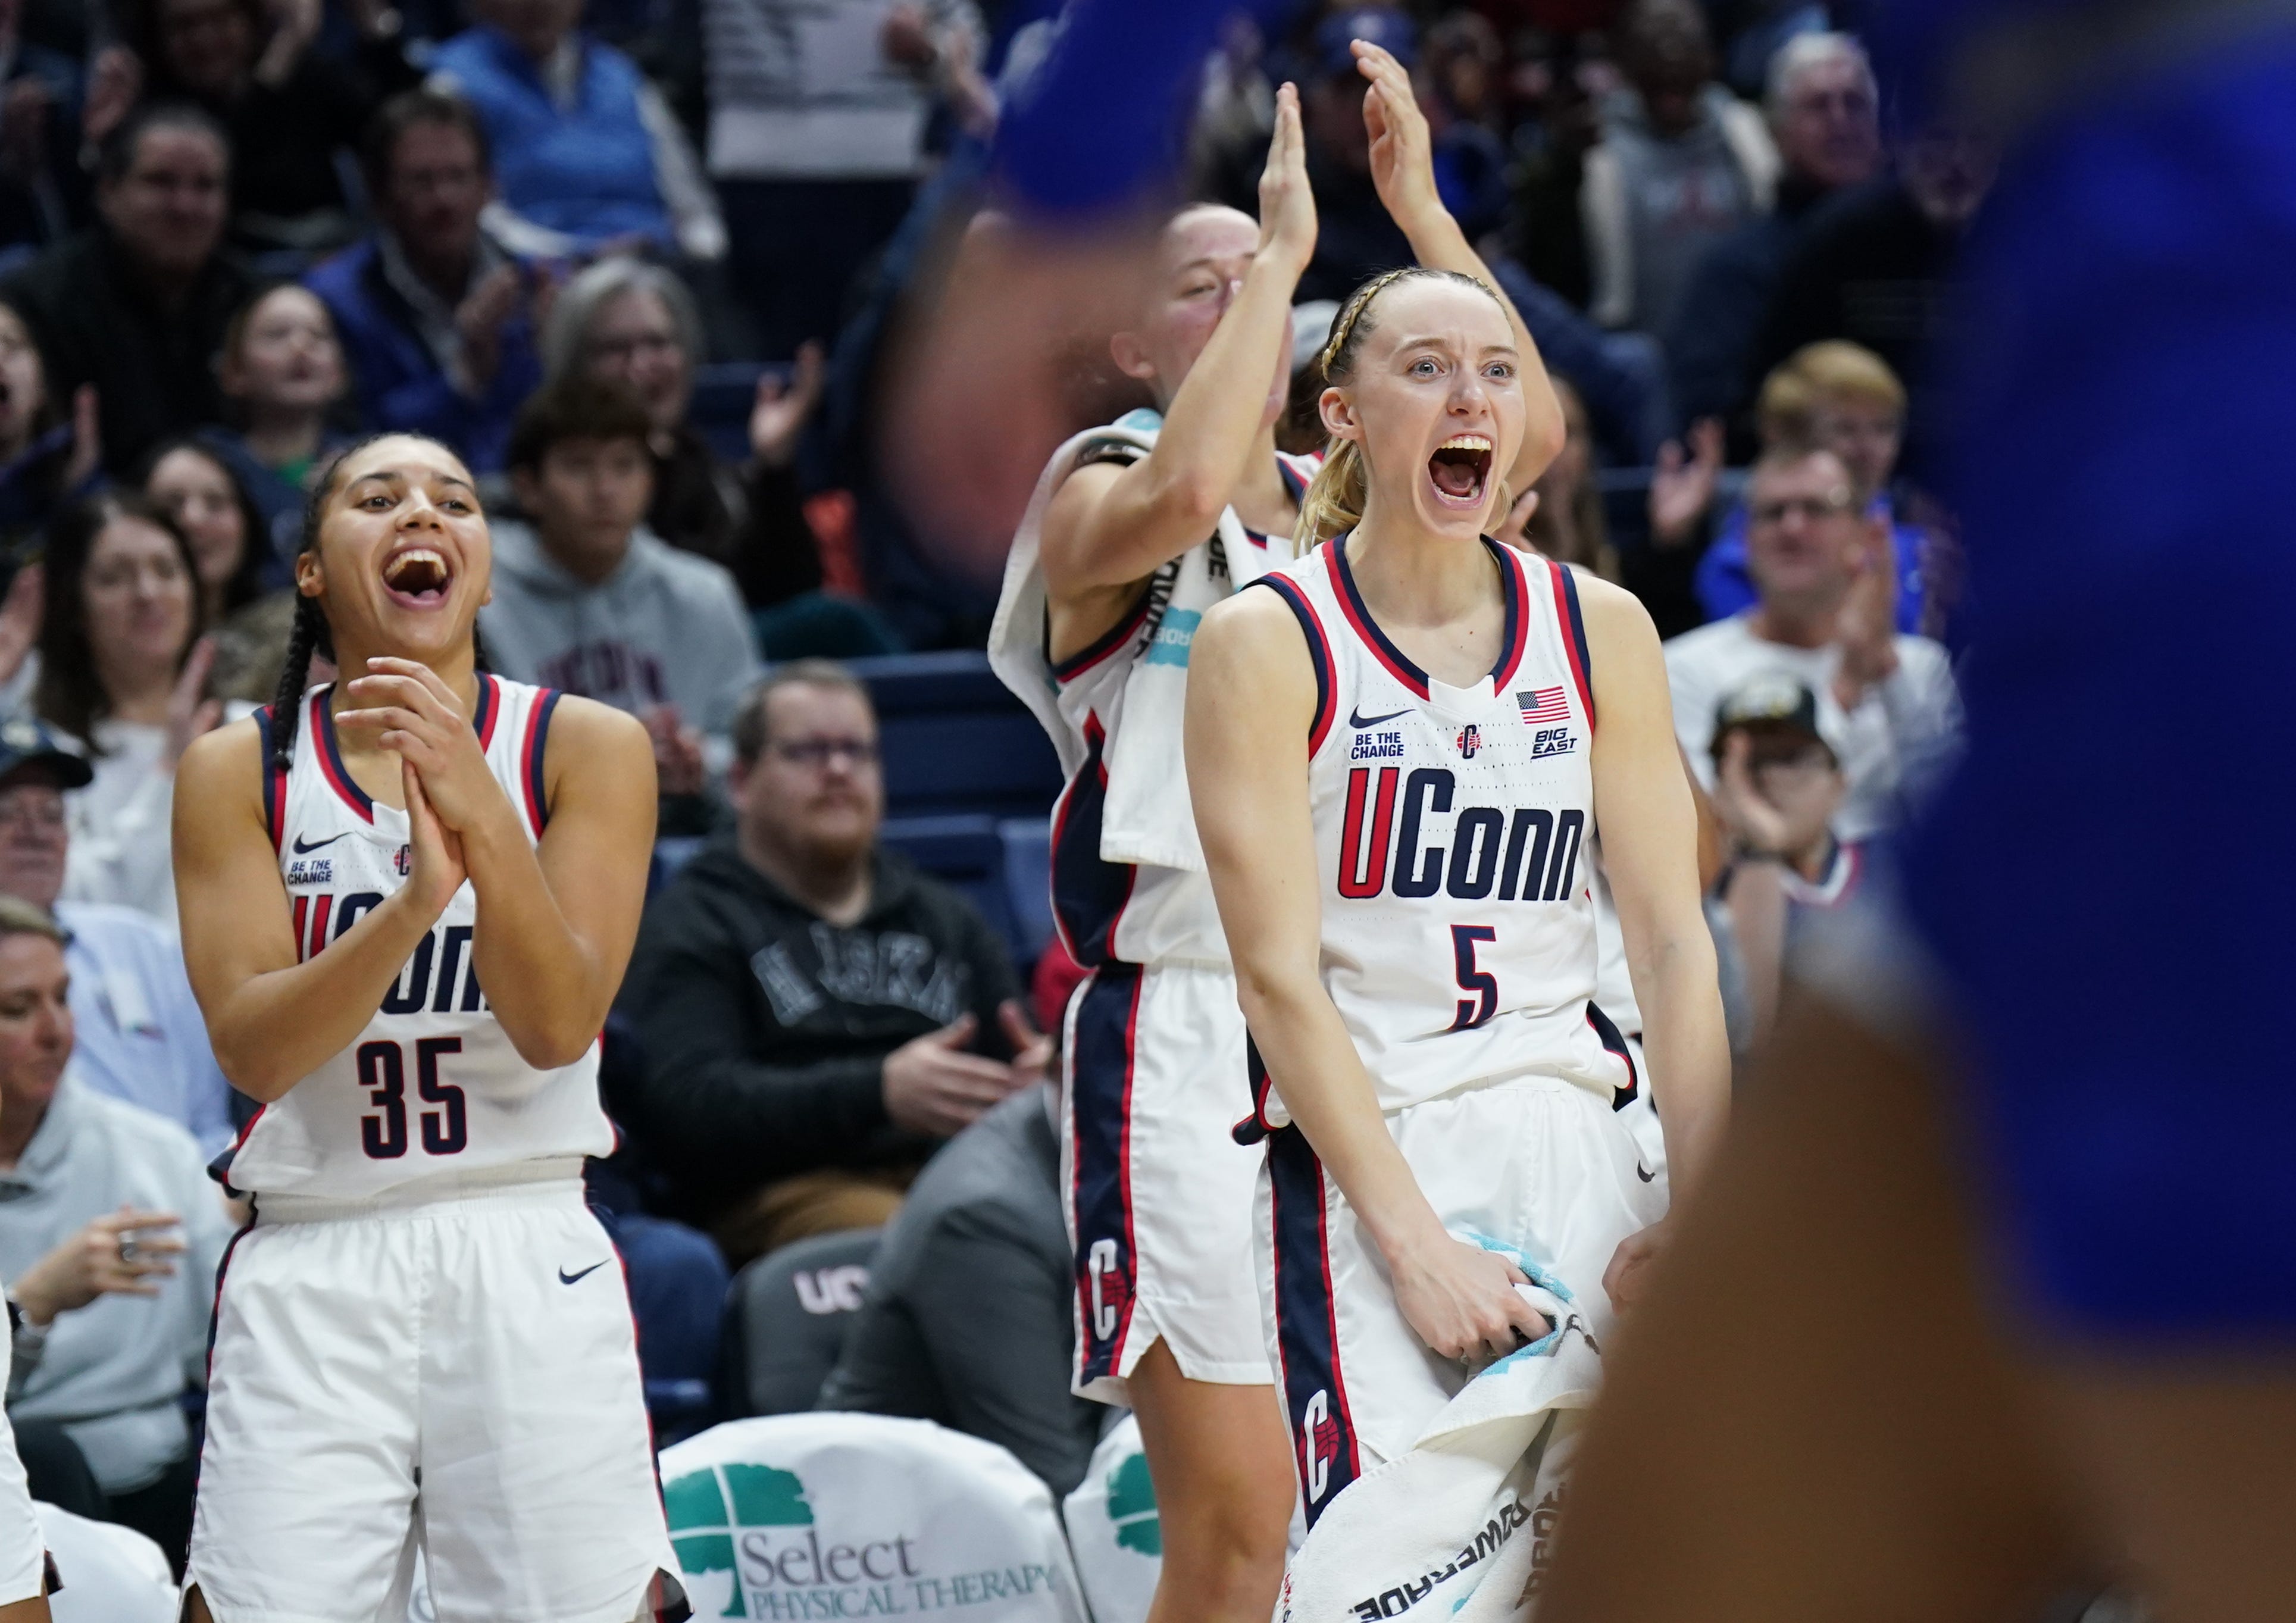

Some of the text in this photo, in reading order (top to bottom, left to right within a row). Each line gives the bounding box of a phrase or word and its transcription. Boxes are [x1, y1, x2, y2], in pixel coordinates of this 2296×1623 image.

[1355, 732, 1401, 746] BE THE
[1534, 727, 1568, 743] BIG
[1350, 744, 1404, 760] CHANGE
[1532, 738, 1578, 755] EAST
[291, 859, 332, 873] BE THE
[287, 870, 332, 885] CHANGE
[1447, 924, 1498, 1031] 5
[356, 1037, 467, 1159] 35
[742, 1530, 921, 1588] Select
[752, 1561, 1056, 1621] PHYSICAL THERAPY
